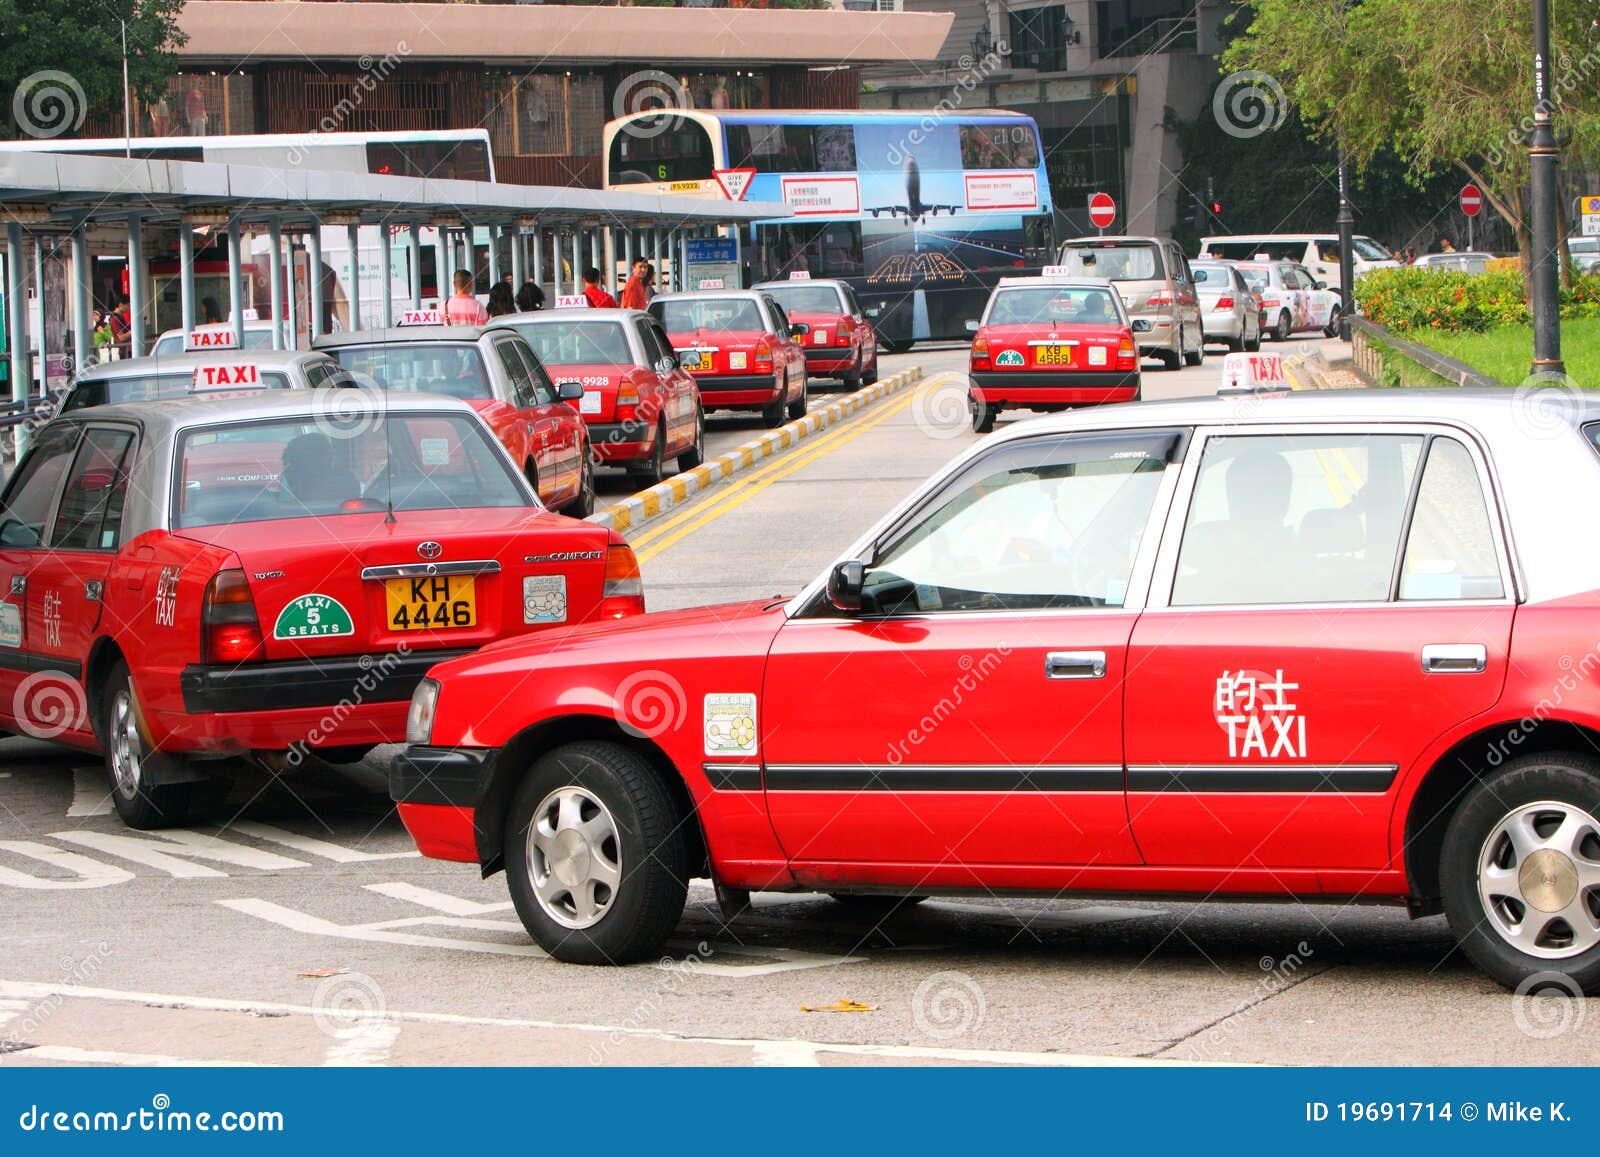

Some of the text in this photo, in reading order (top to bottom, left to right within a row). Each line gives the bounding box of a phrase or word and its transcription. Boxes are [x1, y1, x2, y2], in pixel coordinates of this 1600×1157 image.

[1535, 53, 1542, 69] AB
[658, 165, 667, 179] 6
[866, 253, 964, 283] RMB
[1045, 267, 1068, 275] TAXI
[791, 271, 810, 279] TAXI
[701, 280, 721, 288] TAXI
[558, 297, 586, 306] TAXI
[404, 312, 437, 323] TAXI
[191, 332, 231, 346] TAXI
[1046, 345, 1060, 355] KB
[1039, 354, 1069, 365] 4569
[203, 366, 257, 385] TAXI
[1248, 357, 1284, 382] TAXI
[583, 376, 609, 386] 9928
[550, 551, 603, 560] COMFORT
[254, 571, 285, 580] TOYOTA
[411, 577, 450, 604] KH
[295, 597, 331, 610] TAXI
[155, 596, 176, 627] TAXI
[306, 607, 321, 625] 5
[393, 601, 471, 629] 4446
[288, 624, 340, 636] SEATS
[1216, 669, 1299, 712] 的士
[1217, 715, 1307, 758] TAXI
